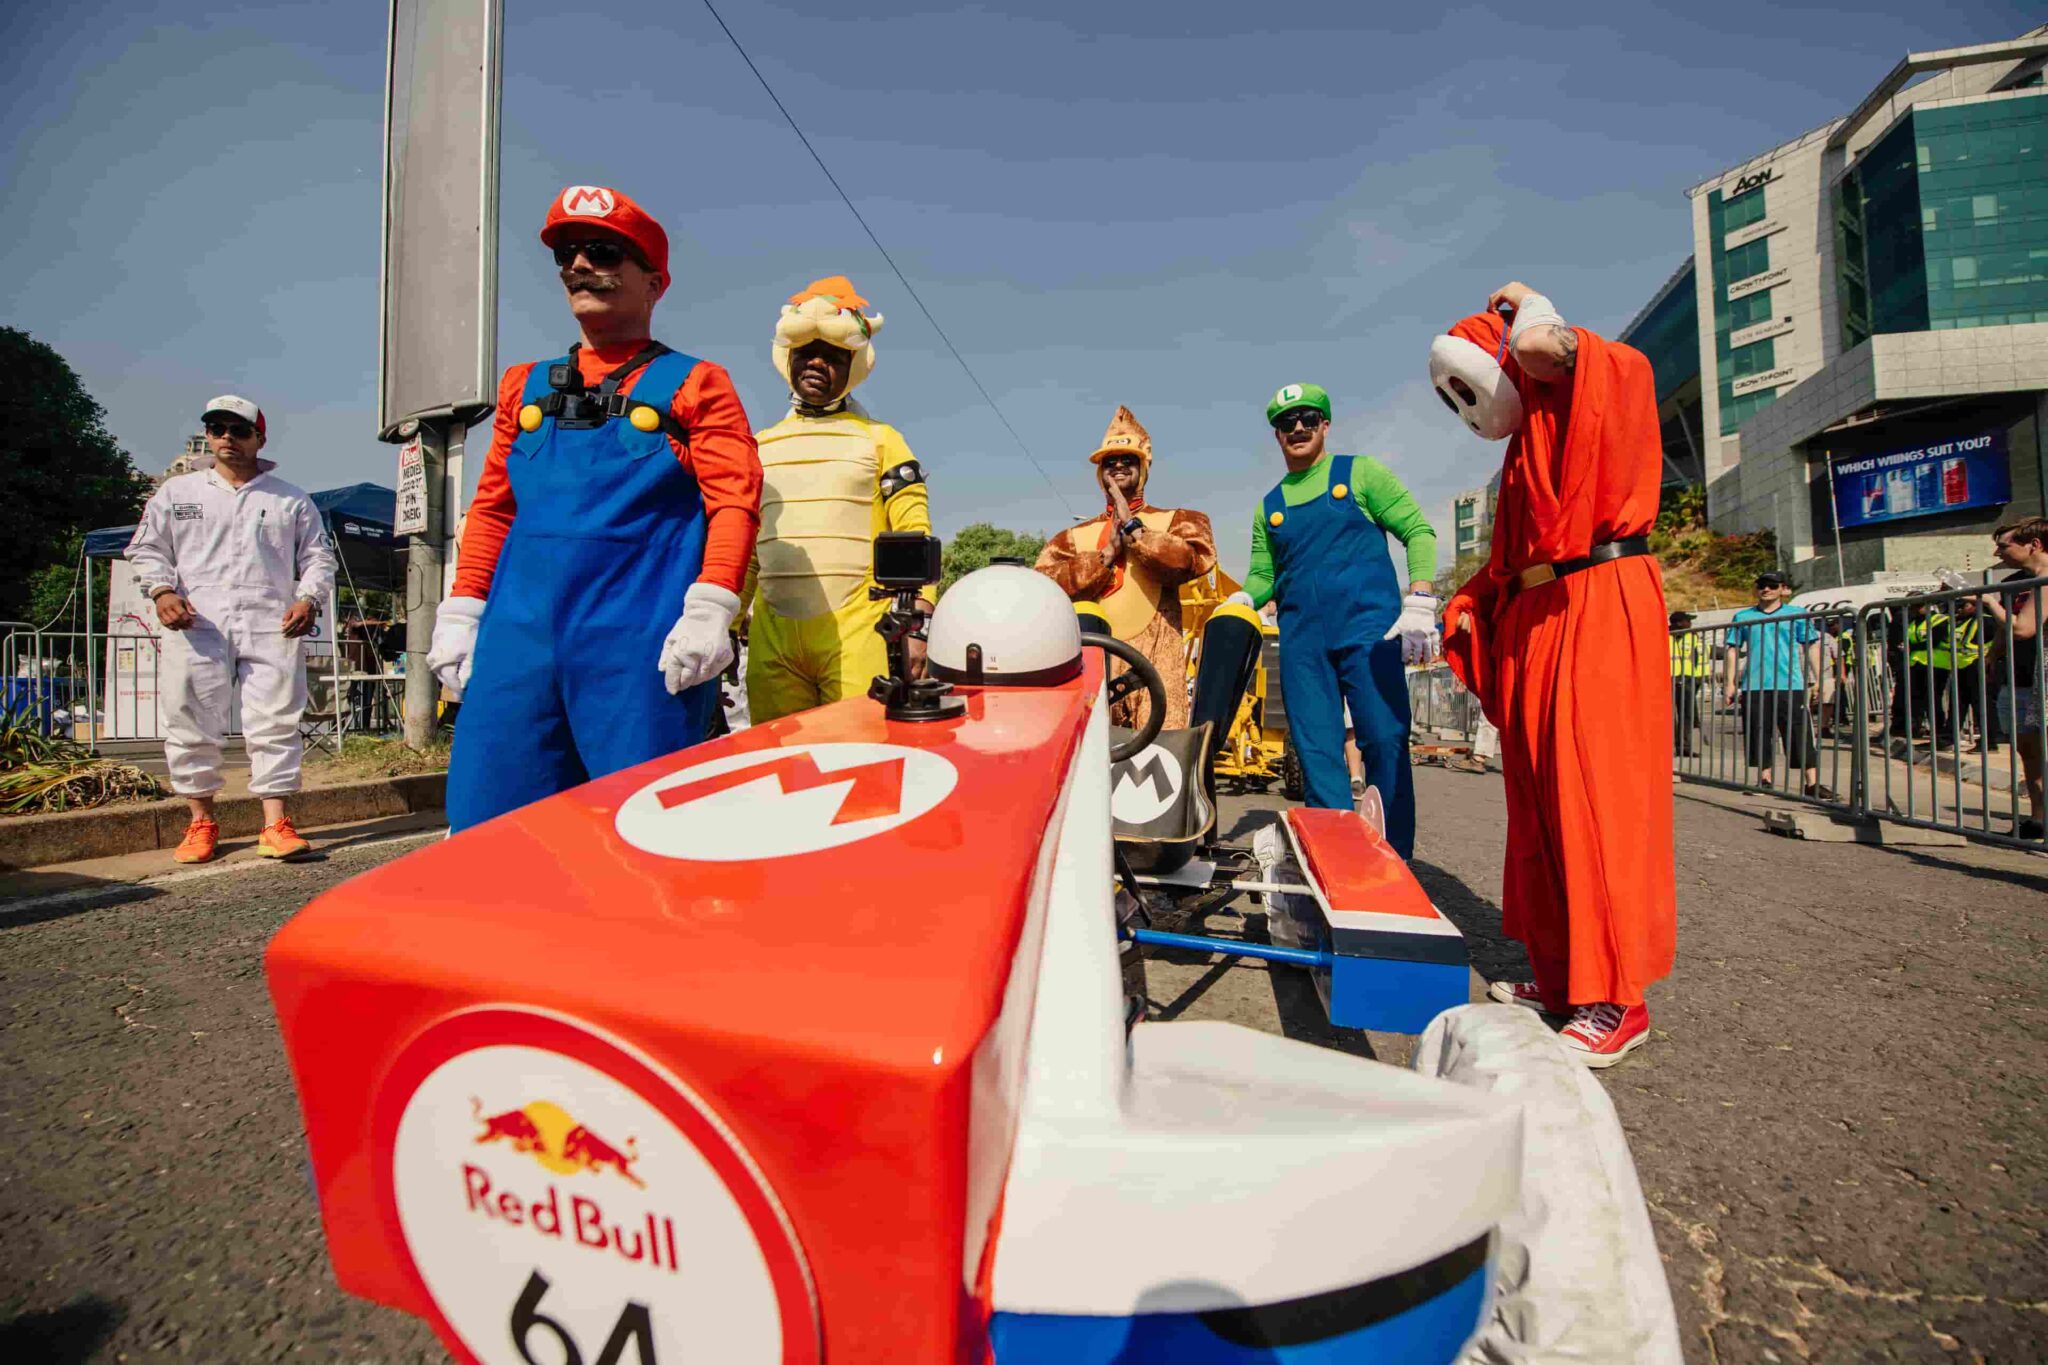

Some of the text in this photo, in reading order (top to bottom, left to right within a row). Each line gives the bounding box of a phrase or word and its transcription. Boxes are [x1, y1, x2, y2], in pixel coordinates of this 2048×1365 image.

[569, 188, 609, 211] M
[1732, 168, 1772, 195] AON
[1283, 388, 1296, 401] L
[1837, 459, 1875, 475] WHICH
[1927, 443, 1954, 458] SUIT
[1955, 436, 1992, 452] YOU?
[655, 751, 905, 826] M
[1111, 753, 1174, 803] M
[463, 1164, 678, 1272] Red Bull
